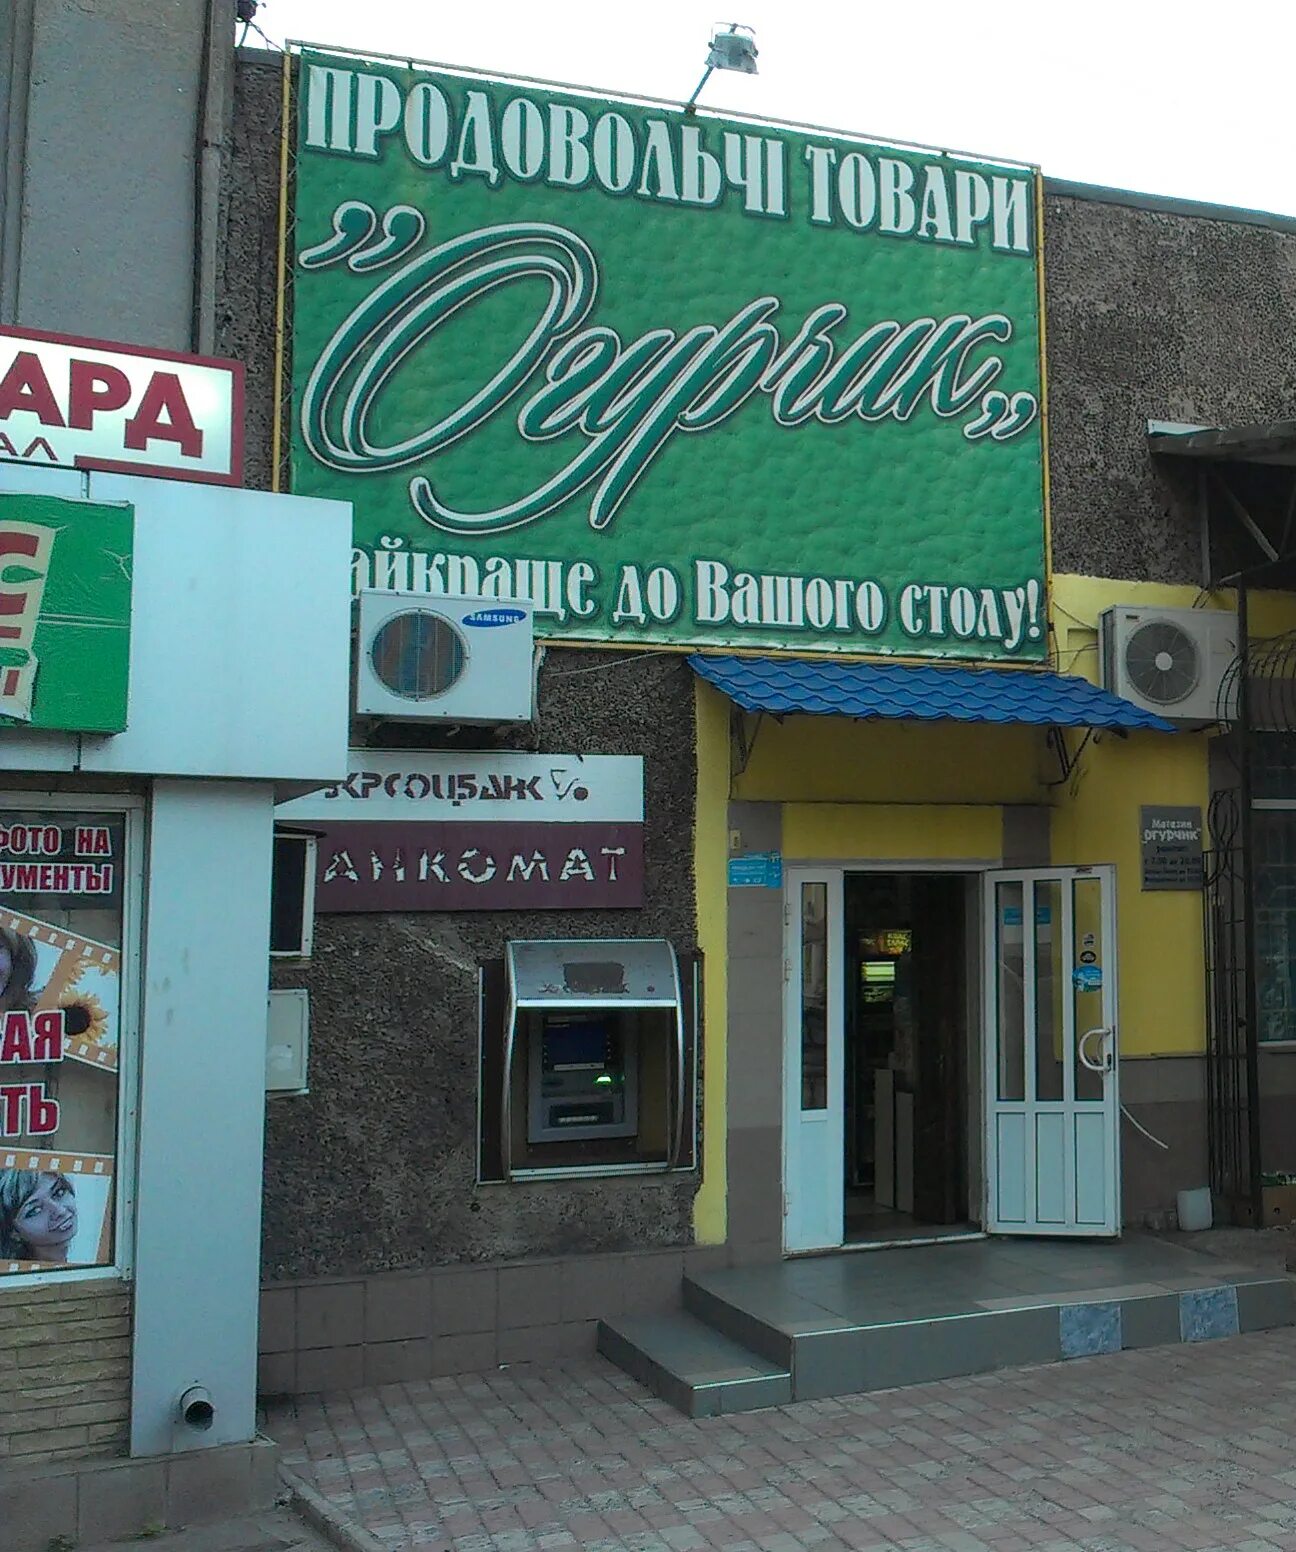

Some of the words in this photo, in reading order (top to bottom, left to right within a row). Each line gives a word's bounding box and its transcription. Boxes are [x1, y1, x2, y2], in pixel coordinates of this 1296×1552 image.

[306, 64, 786, 218] ПРОДОВОЛЬЧІ
[804, 144, 1032, 254] ТОВАРИ
[0, 350, 205, 459] АРД
[469, 613, 520, 624] SAMSUNG
[612, 565, 678, 624] до
[696, 560, 885, 632] Вашого
[900, 578, 1042, 649] столу!
[75, 827, 112, 856] НА
[0, 862, 113, 893] УМЕНТЫ
[0, 1010, 66, 1064] АЯ
